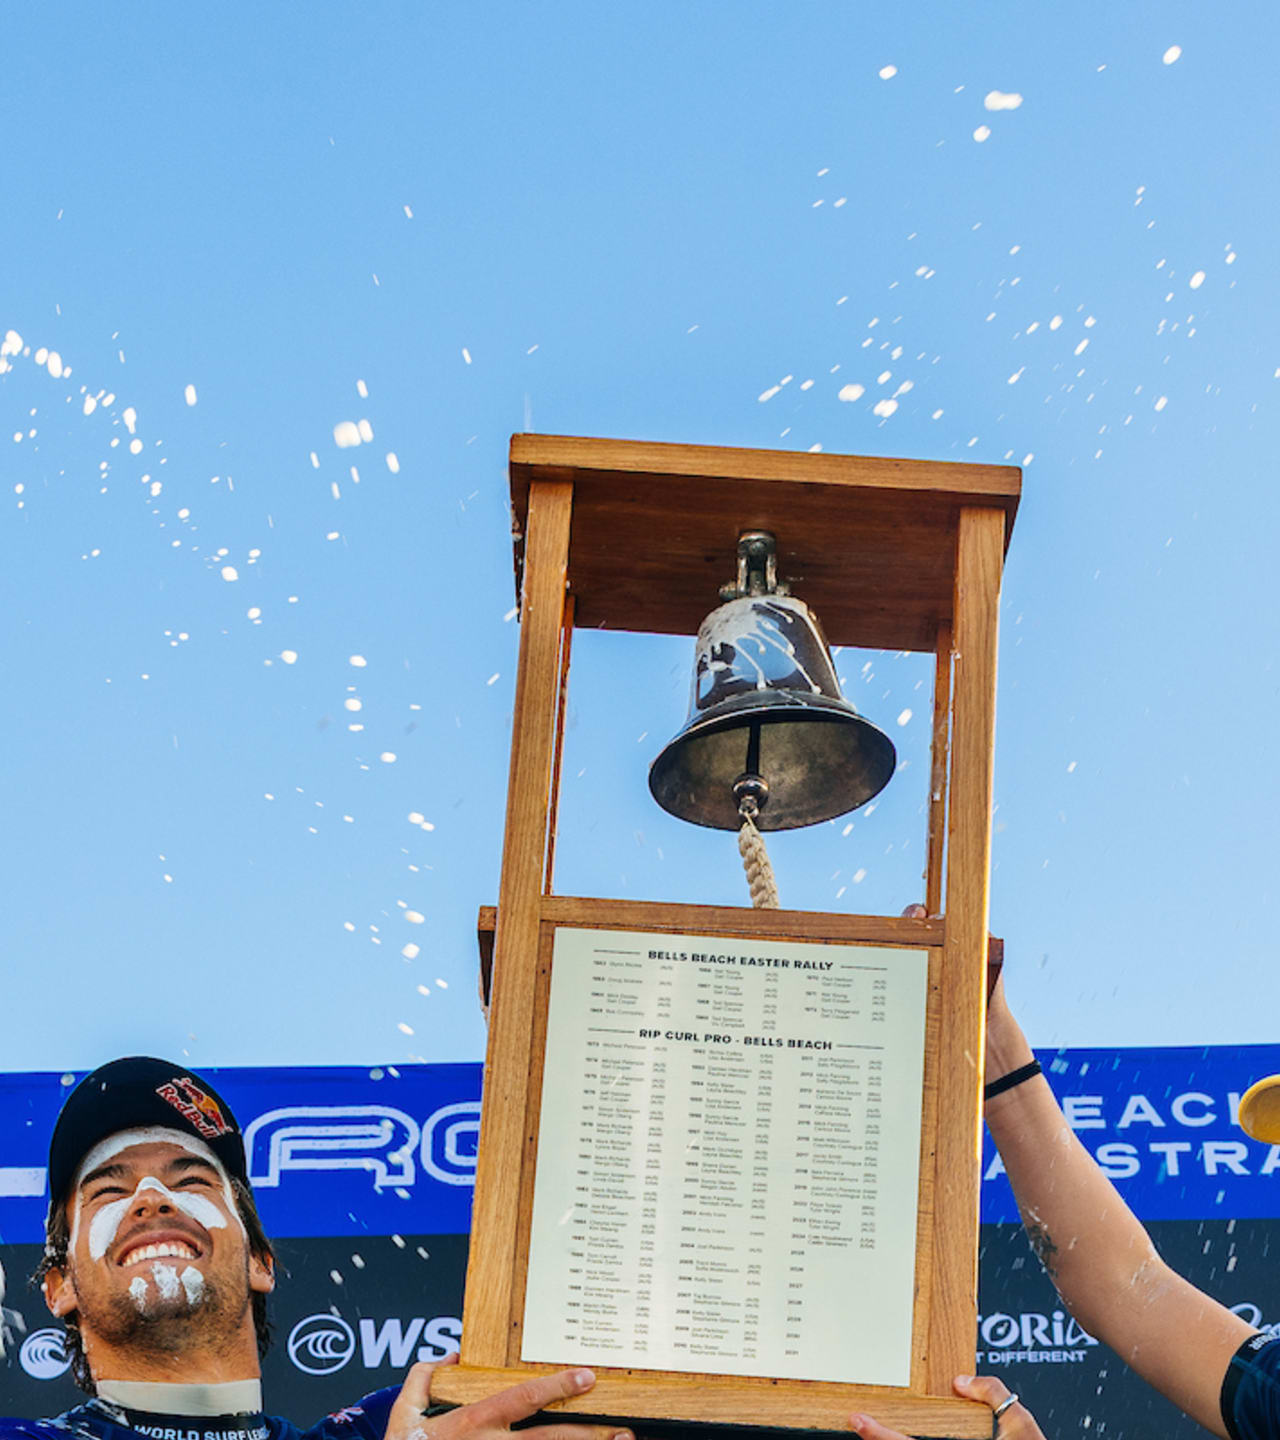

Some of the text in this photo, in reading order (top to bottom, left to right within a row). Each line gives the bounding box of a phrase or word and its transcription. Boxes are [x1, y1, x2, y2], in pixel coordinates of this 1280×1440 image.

[648, 950, 834, 971] BELLS BEACH EASTER RALLY
[703, 1034, 732, 1045] PRO
[744, 1036, 784, 1048] BELLS
[787, 1039, 833, 1051] BEACH
[358, 1317, 463, 1370] WS
[988, 1350, 1087, 1364] DIFFERENT
